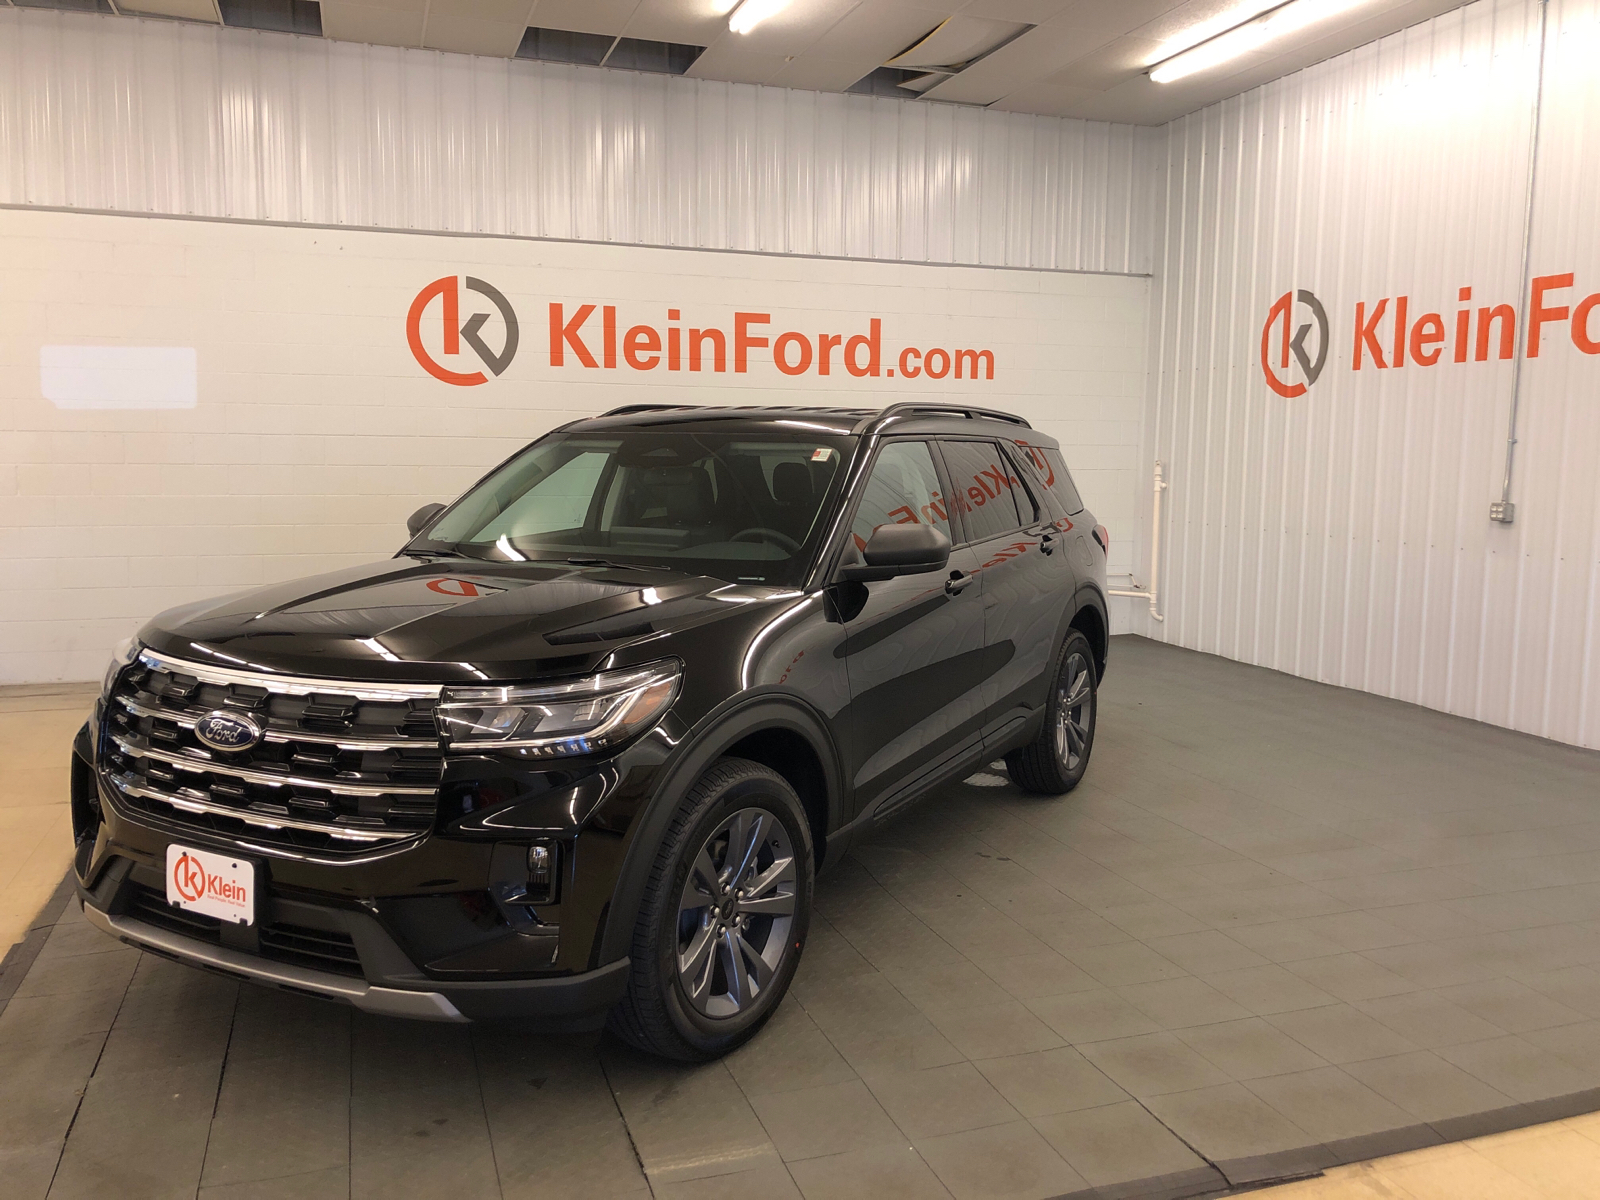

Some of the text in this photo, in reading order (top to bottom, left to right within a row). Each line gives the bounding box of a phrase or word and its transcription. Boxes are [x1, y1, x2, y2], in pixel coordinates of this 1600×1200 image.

[549, 302, 995, 380] KleinFord.com
[205, 718, 242, 742] Ford
[207, 873, 246, 902] Klein
